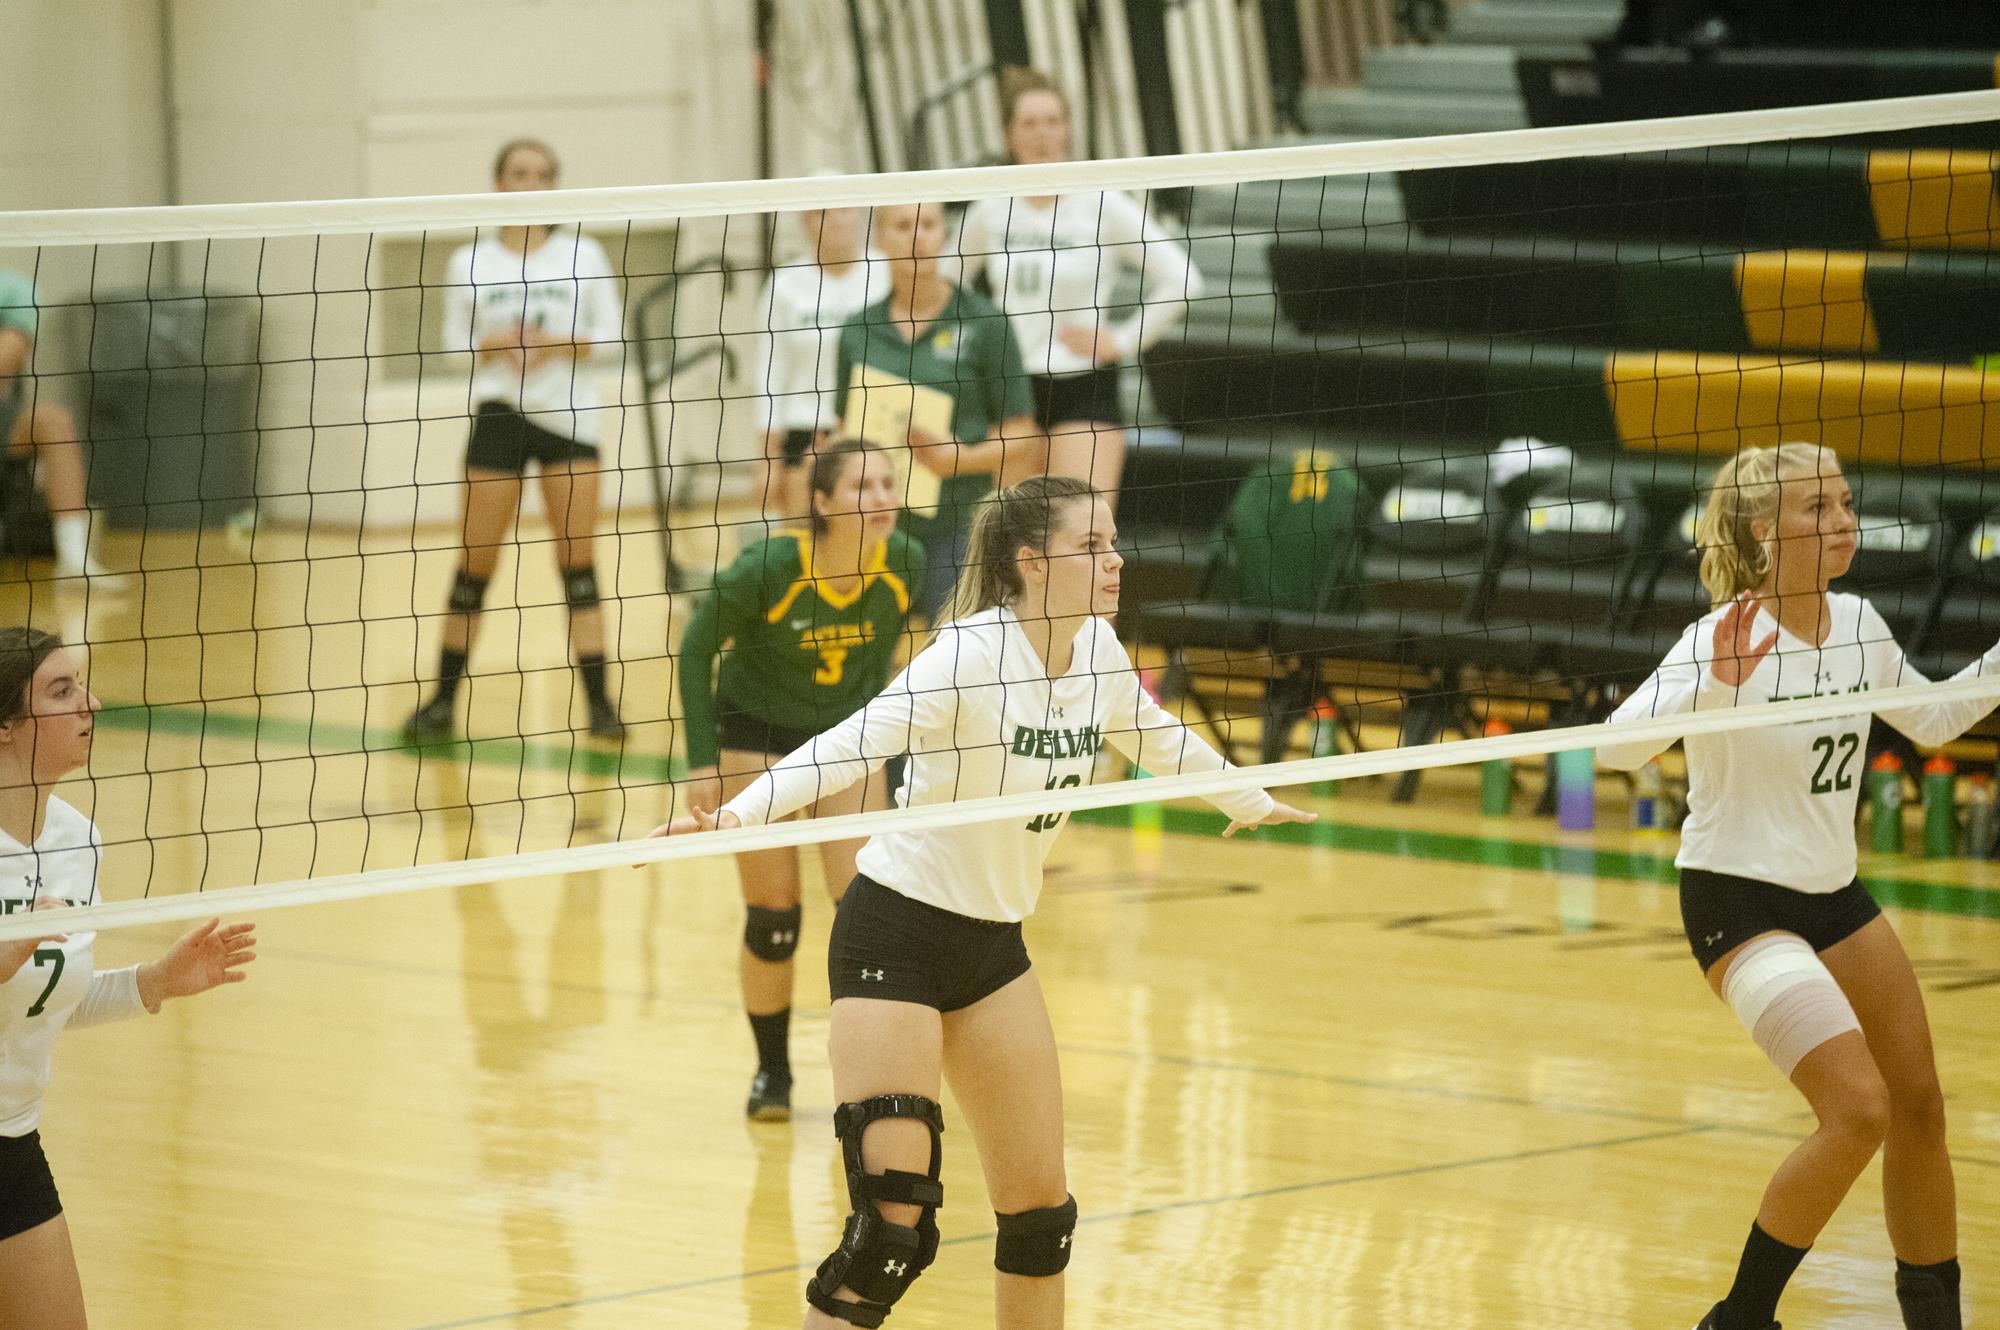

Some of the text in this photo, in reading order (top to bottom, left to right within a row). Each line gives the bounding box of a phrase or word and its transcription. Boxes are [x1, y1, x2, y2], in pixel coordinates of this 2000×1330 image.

[812, 648, 848, 685] 3
[1810, 732, 1860, 794] 22
[26, 949, 66, 1018] 7
